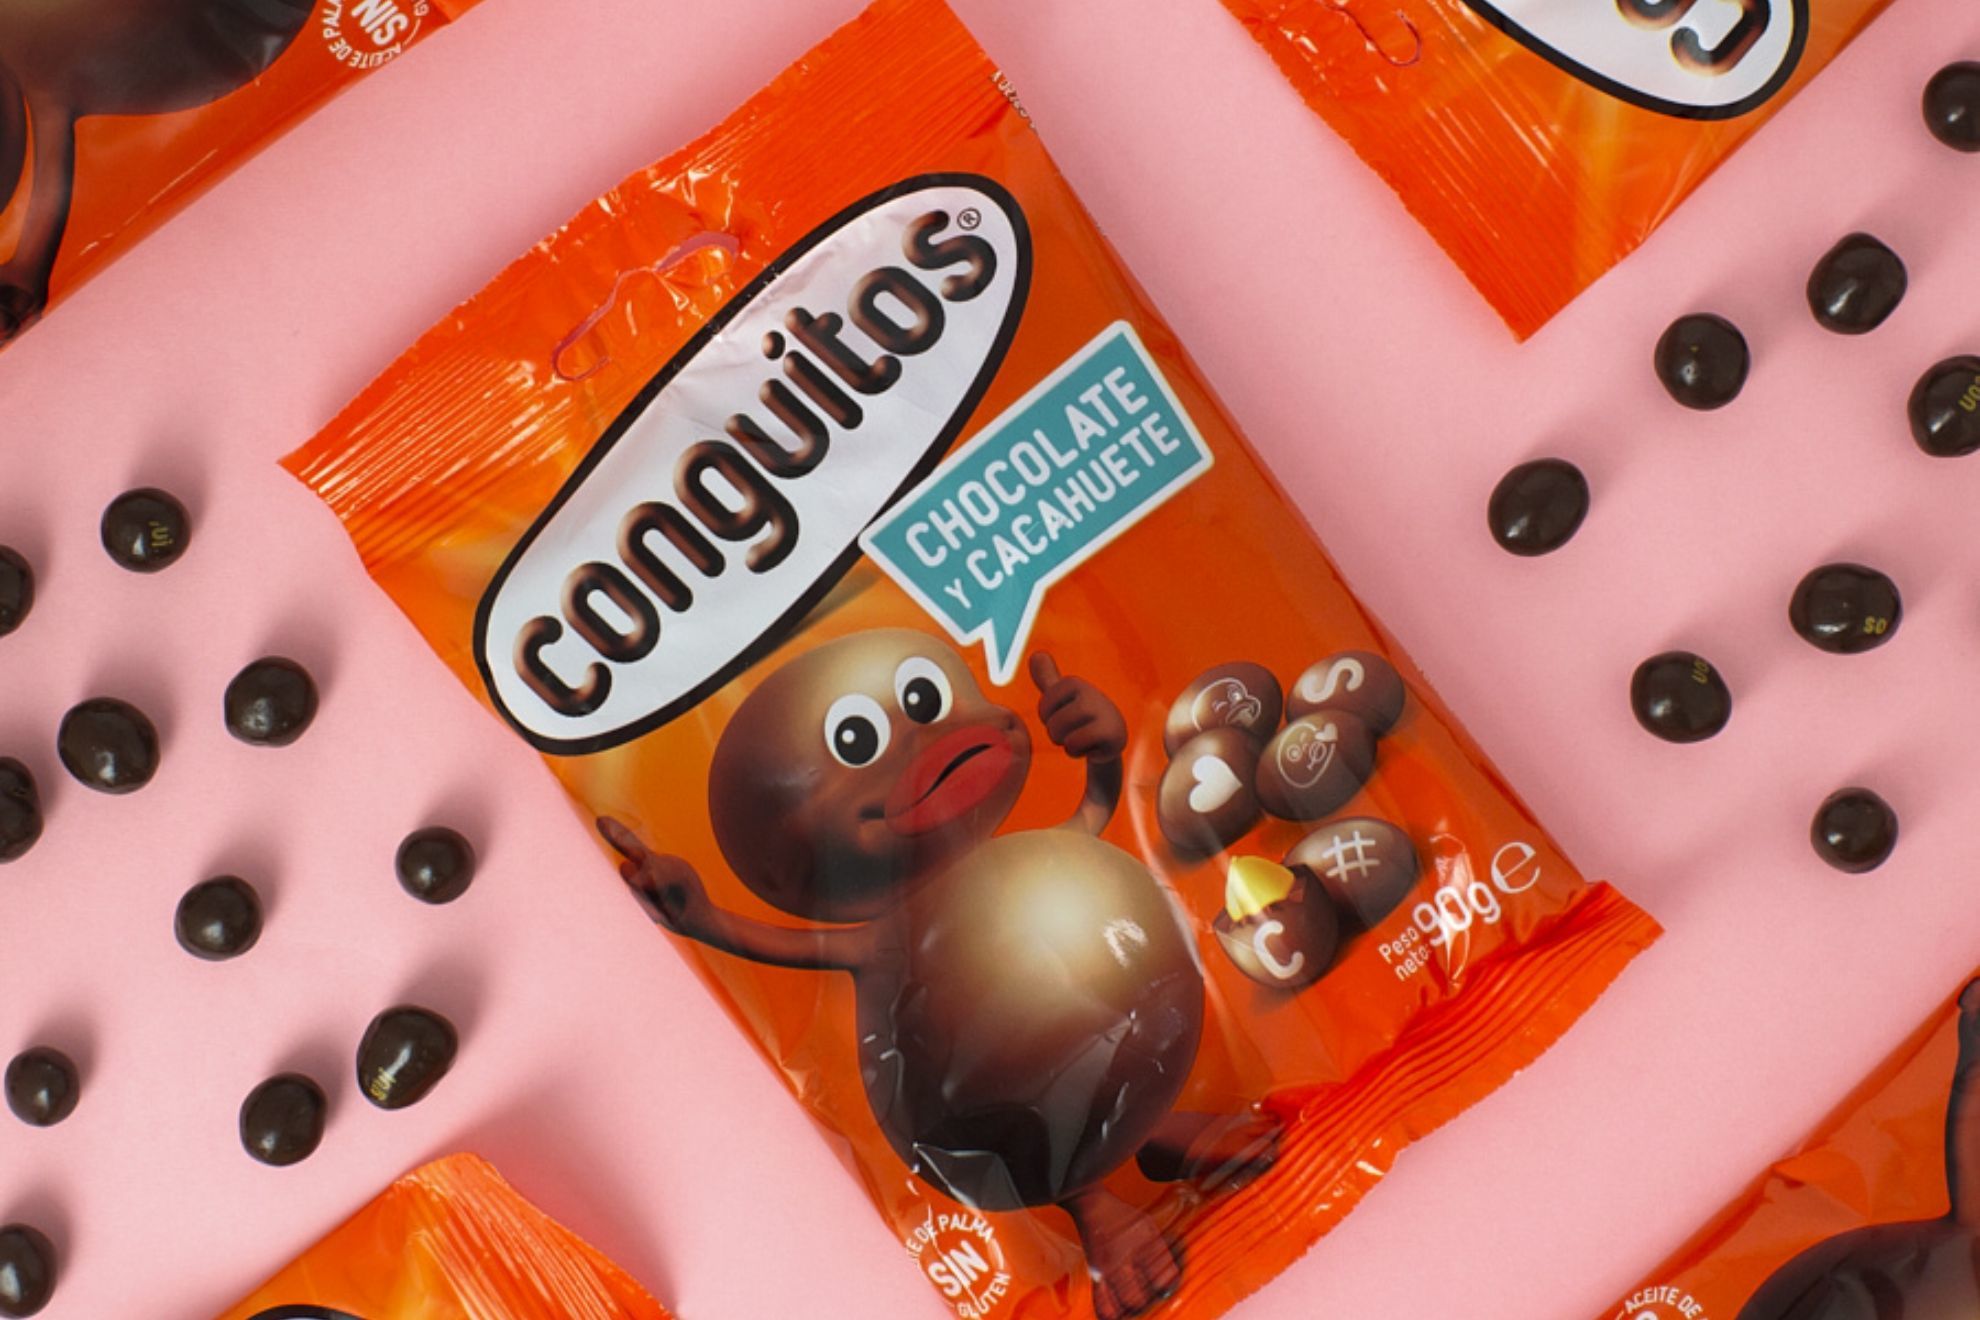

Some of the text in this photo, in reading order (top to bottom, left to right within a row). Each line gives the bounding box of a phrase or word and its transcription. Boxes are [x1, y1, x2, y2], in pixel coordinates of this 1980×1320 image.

[328, 37, 353, 61] DE
[905, 366, 1149, 567] CHOCOLATE
[944, 412, 1180, 609] Y CACAHUETE
[1412, 881, 1501, 947] 90g
[1378, 926, 1420, 964] Peso
[937, 1212, 994, 1243] PALMA
[928, 1240, 989, 1297] SIN
[957, 1271, 1011, 1319] GLUTEN
[1625, 1286, 1680, 1314] ACEITE
